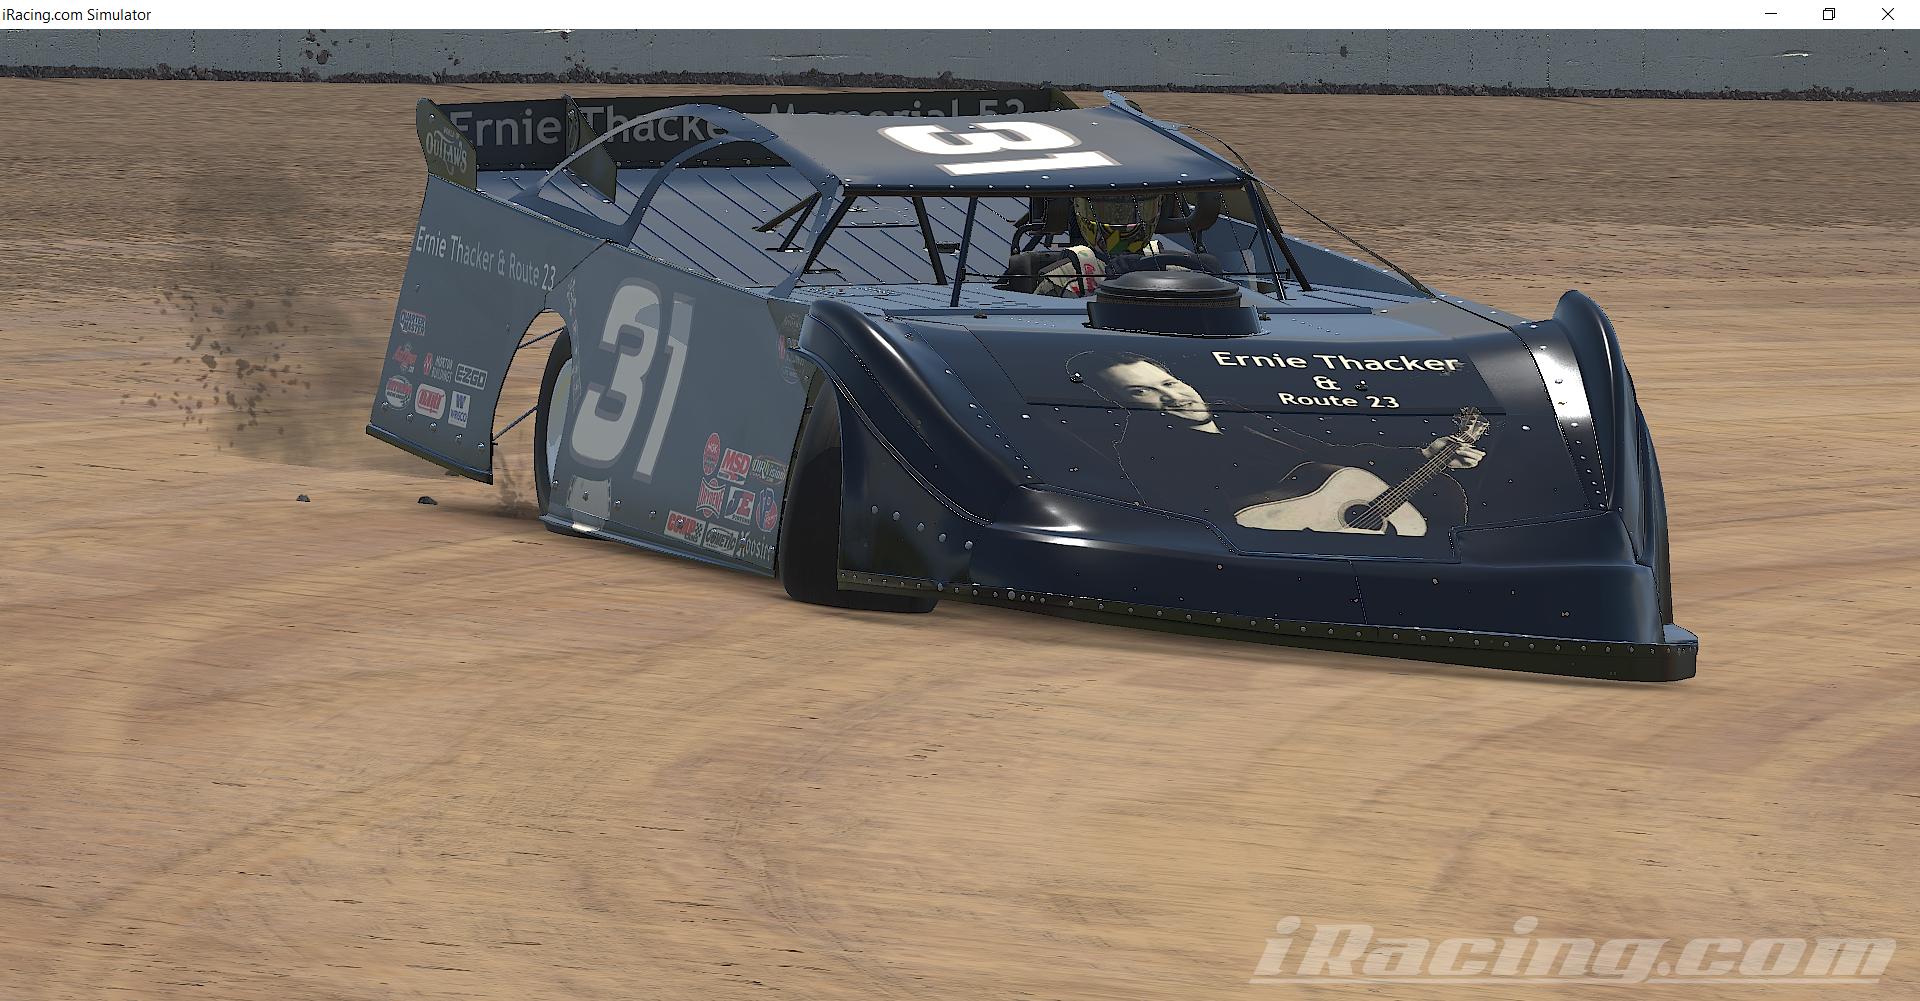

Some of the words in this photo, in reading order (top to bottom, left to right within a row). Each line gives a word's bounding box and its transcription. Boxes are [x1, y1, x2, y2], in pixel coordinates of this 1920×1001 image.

[2, 8, 83, 23] iRacing.com
[87, 8, 152, 21] Simulator
[578, 103, 728, 143] Thacke
[876, 120, 1122, 177] 31
[415, 225, 447, 258] Ernie
[450, 234, 495, 273] Thacker
[497, 248, 506, 277] &
[508, 252, 540, 287] Route
[541, 263, 556, 291] 23
[1211, 351, 1308, 370] Ernie
[1312, 353, 1460, 372] Thacker
[569, 276, 696, 484] 31
[1313, 375, 1341, 391] &
[1277, 392, 1358, 408] Route
[1366, 395, 1400, 409] 23
[721, 449, 751, 477] MSD
